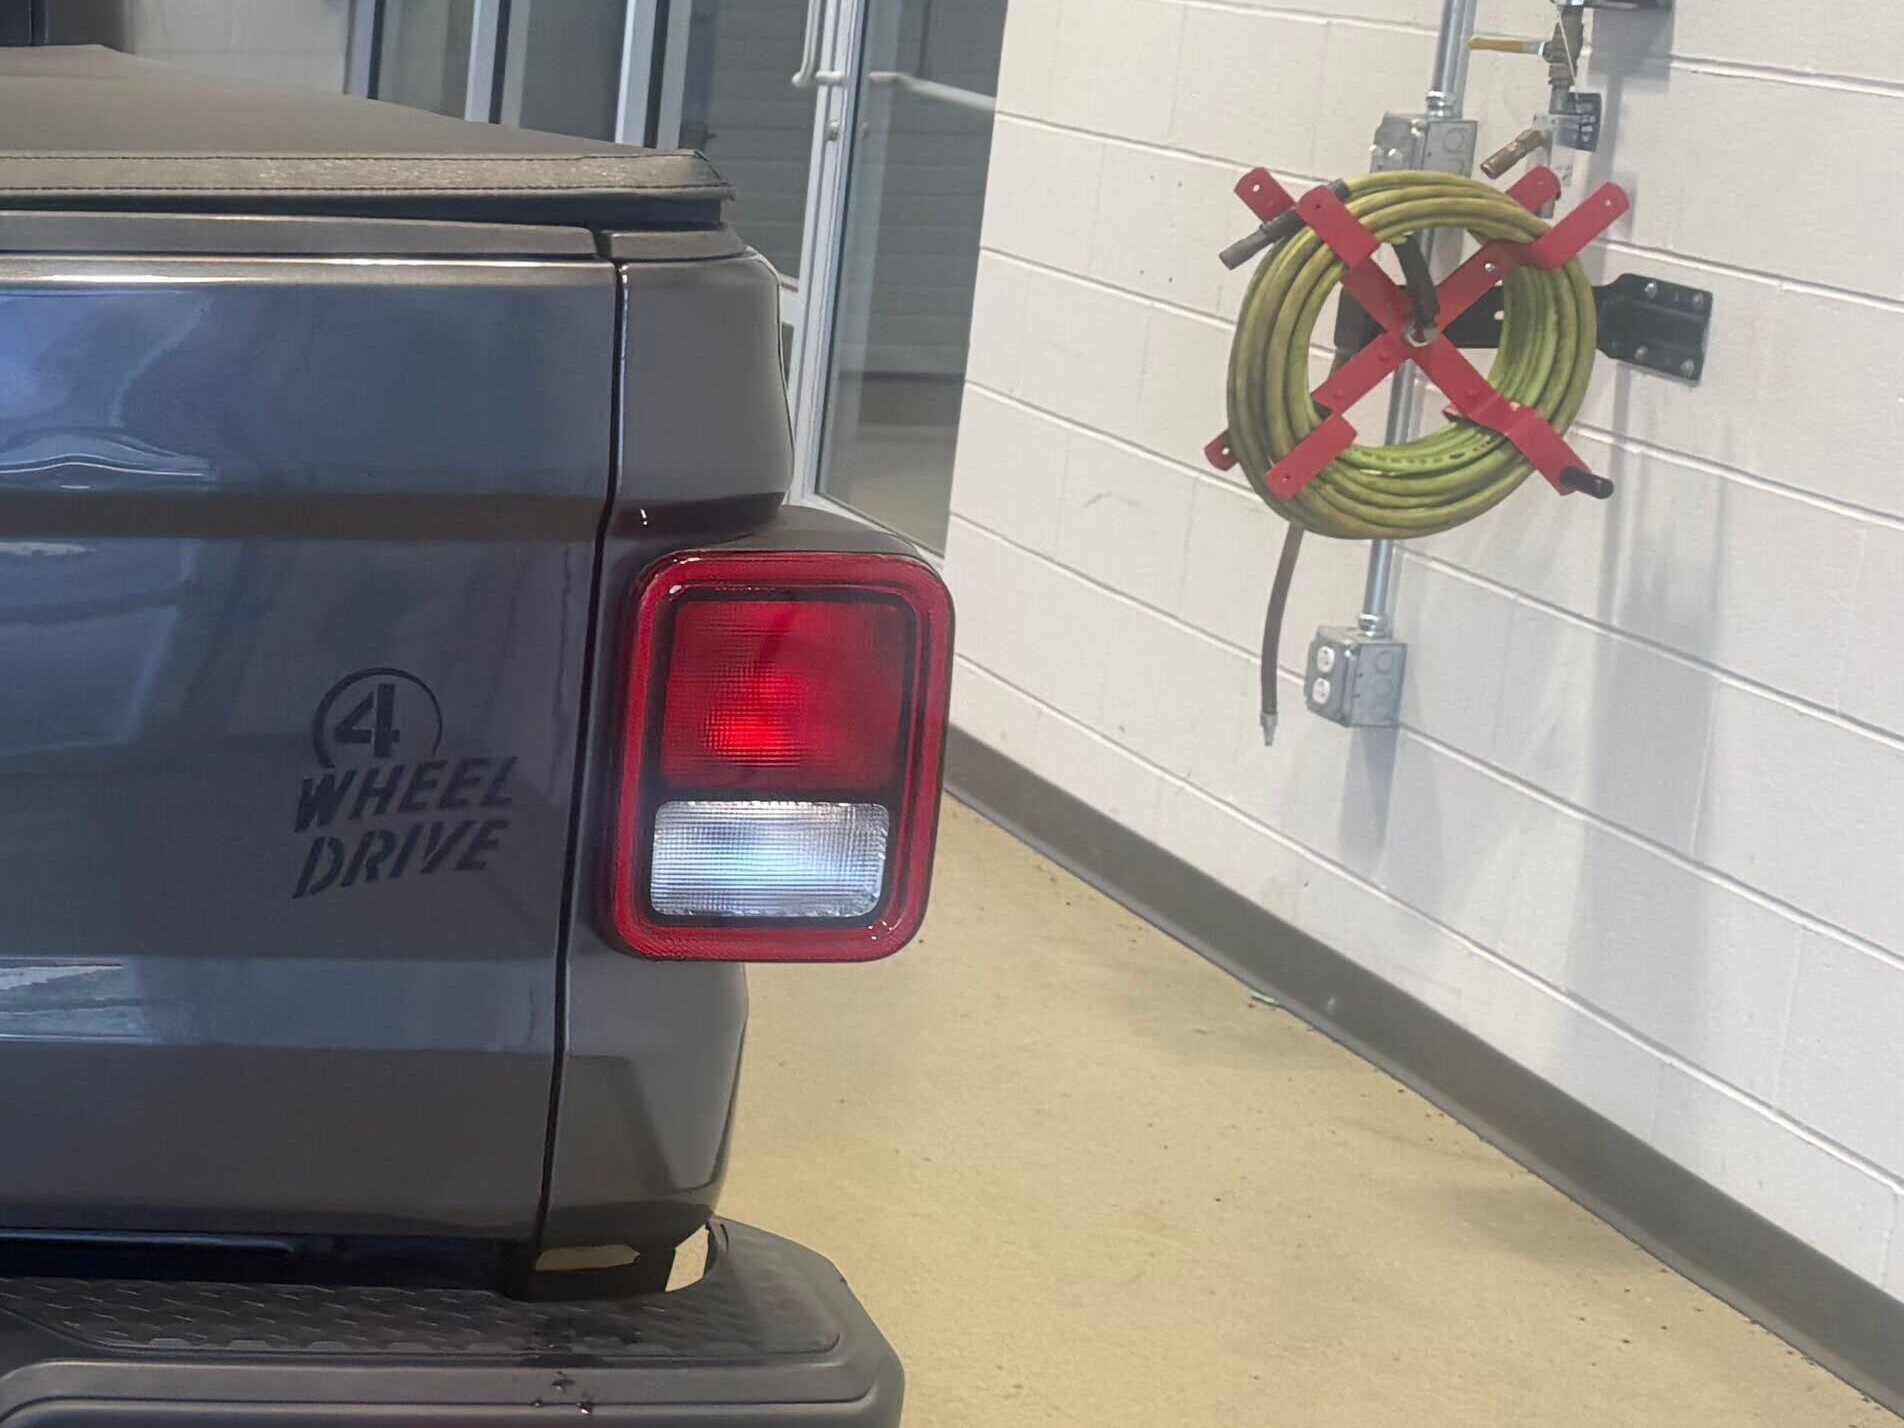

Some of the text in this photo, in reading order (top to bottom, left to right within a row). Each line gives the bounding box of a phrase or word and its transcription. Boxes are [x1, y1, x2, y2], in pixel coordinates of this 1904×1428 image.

[333, 683, 401, 759] 4
[294, 756, 520, 834] WHEEL
[292, 819, 511, 900] DRIVE
